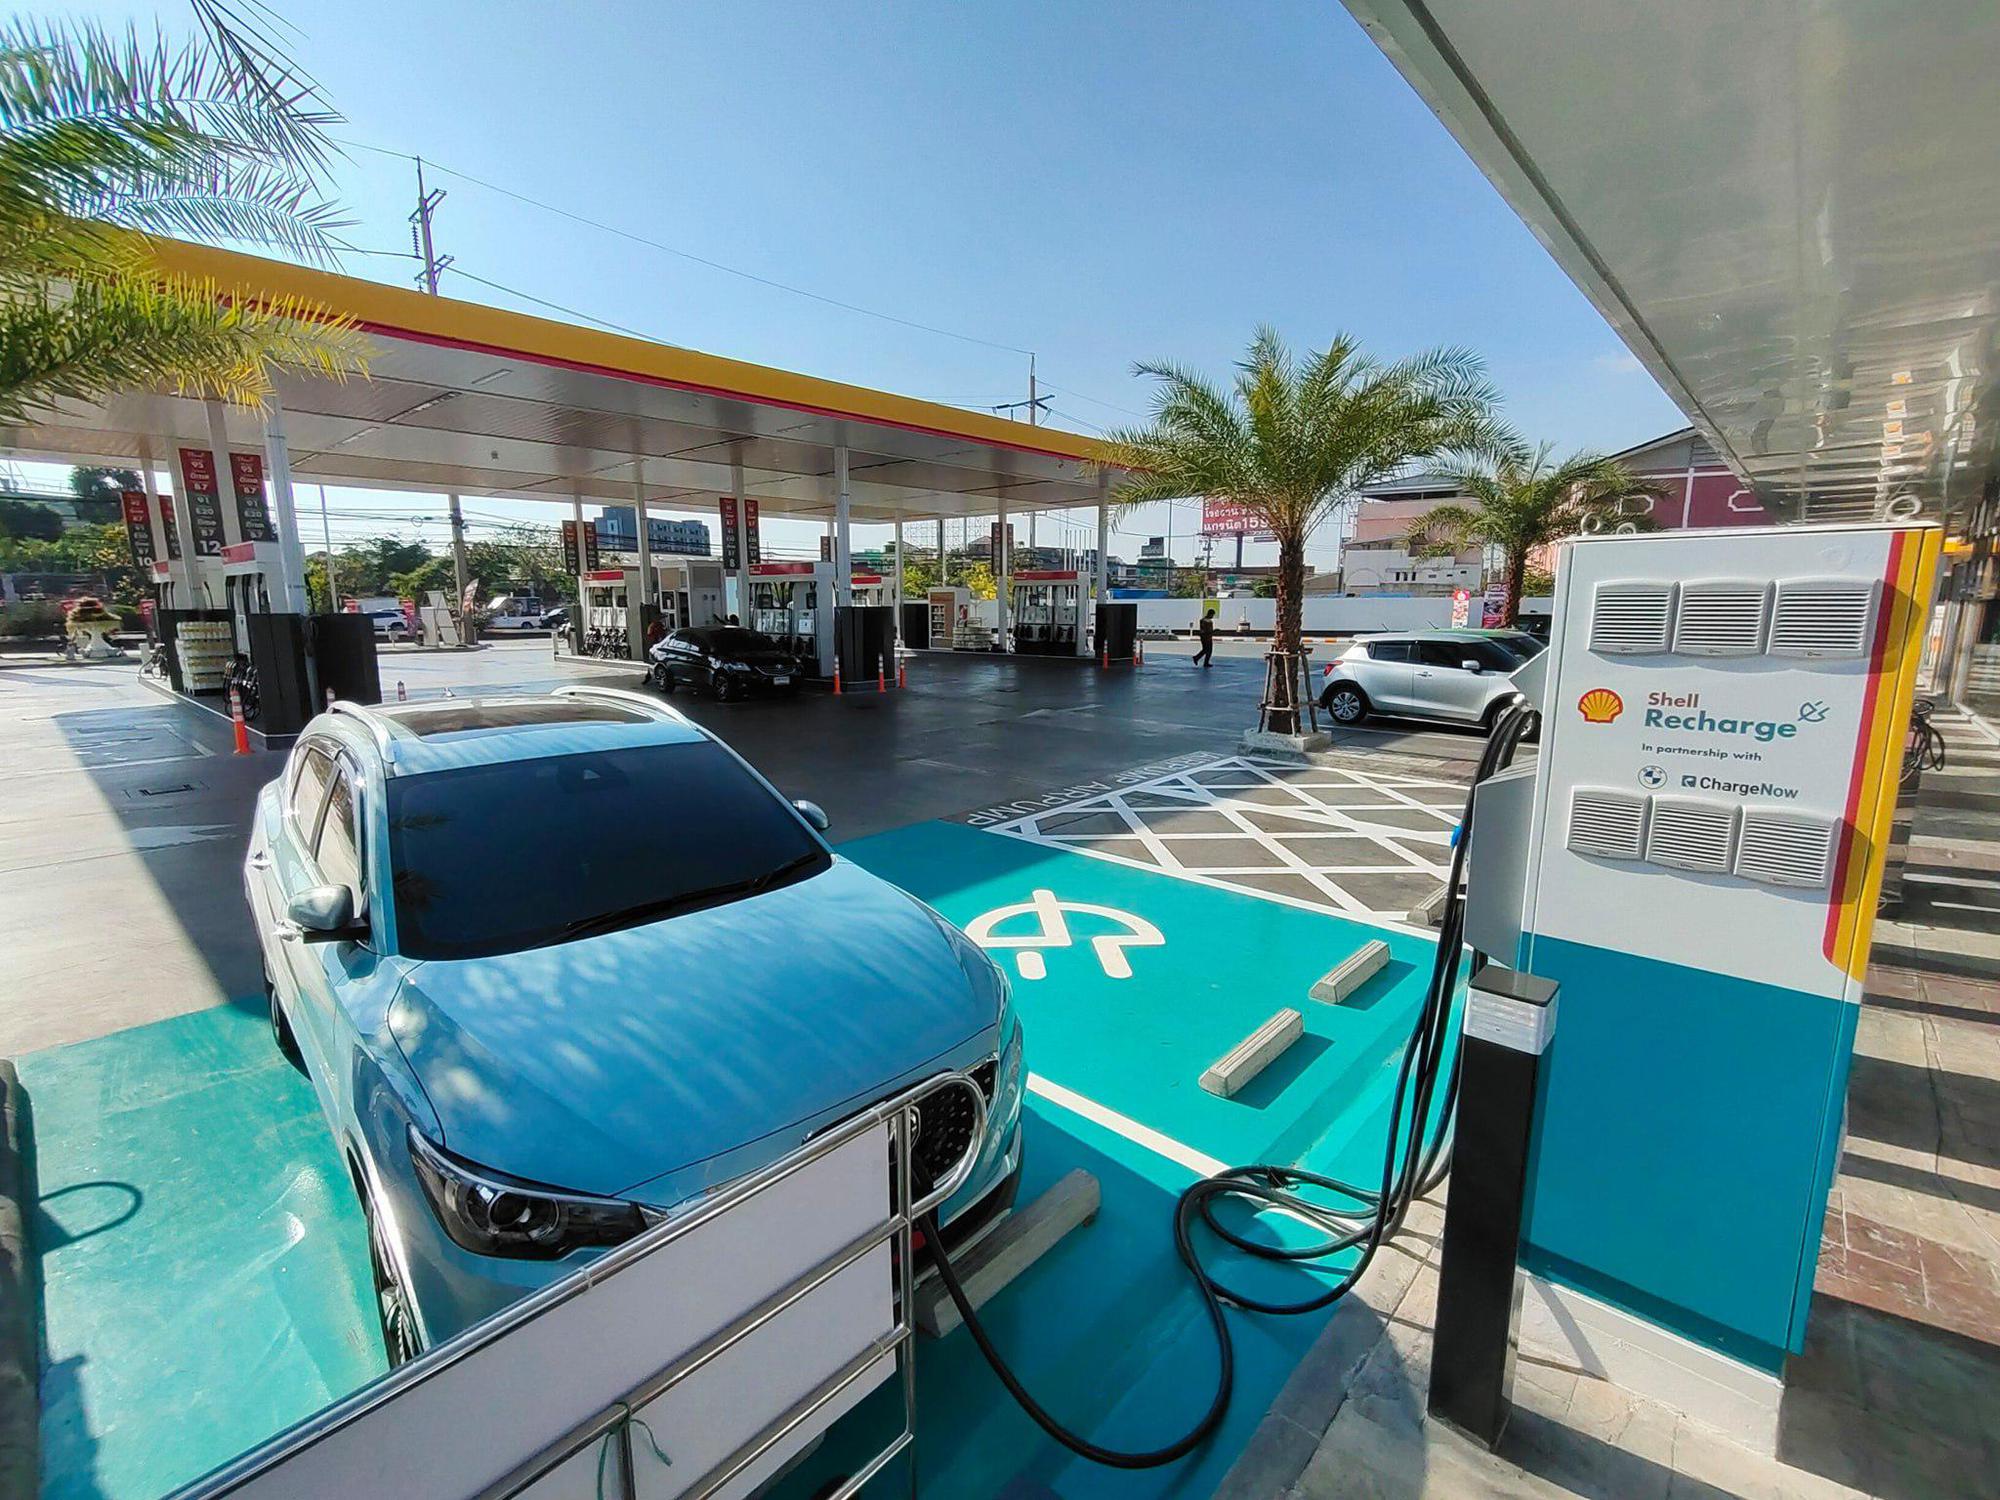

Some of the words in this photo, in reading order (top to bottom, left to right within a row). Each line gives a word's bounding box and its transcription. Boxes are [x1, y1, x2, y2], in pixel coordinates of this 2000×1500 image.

[200, 540, 221, 553] 12
[137, 557, 152, 567] 10
[1647, 691, 1700, 709] Shell
[1643, 708, 1798, 742] Recharge
[1641, 743, 1653, 752] In
[1656, 745, 1729, 760] partnership
[1733, 752, 1763, 762] with
[1699, 776, 1799, 799] ChargeNow
[966, 780, 1112, 826] AIRPUMP
